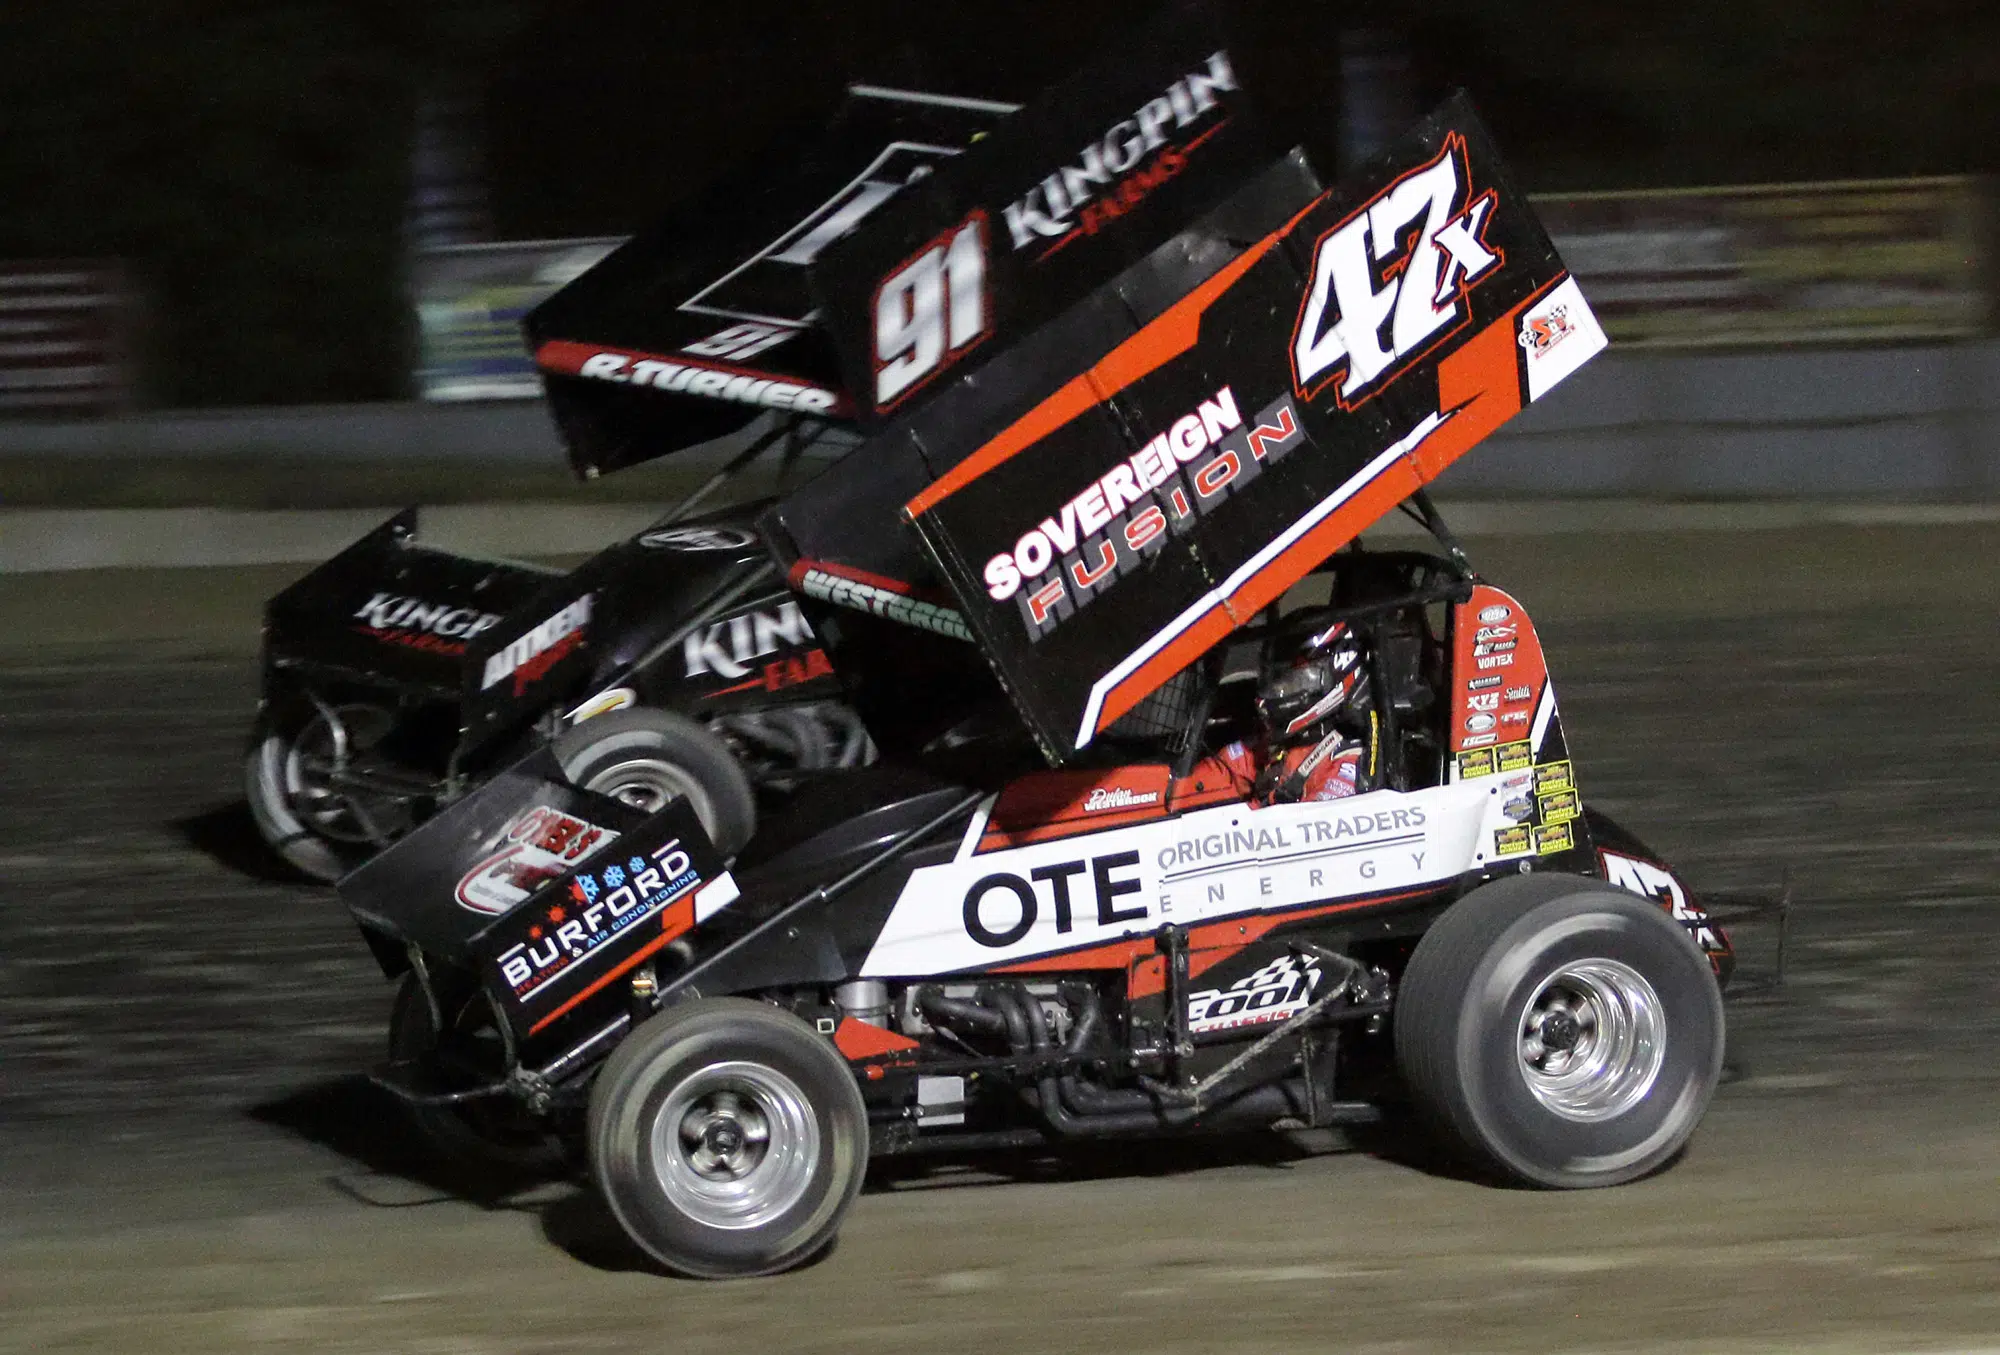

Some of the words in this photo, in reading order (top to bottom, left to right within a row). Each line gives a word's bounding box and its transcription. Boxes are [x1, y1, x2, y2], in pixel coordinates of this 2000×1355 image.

[1001, 50, 1240, 251] KINGPIN
[876, 219, 985, 404] 91
[580, 352, 839, 416] R.TURNER
[984, 385, 1242, 602] SOVEREIGN
[1027, 406, 1297, 625] FUSION
[1478, 653, 1514, 669] VORTEX
[1158, 826, 1291, 871] ORIGINAL
[1297, 806, 1427, 844] TRADERS
[1159, 852, 1426, 914] ENERGY
[502, 850, 690, 988] BURFORD
[587, 929, 608, 948] AIR
[611, 869, 698, 931] CONDITIONING
[962, 850, 1148, 948] OTE
